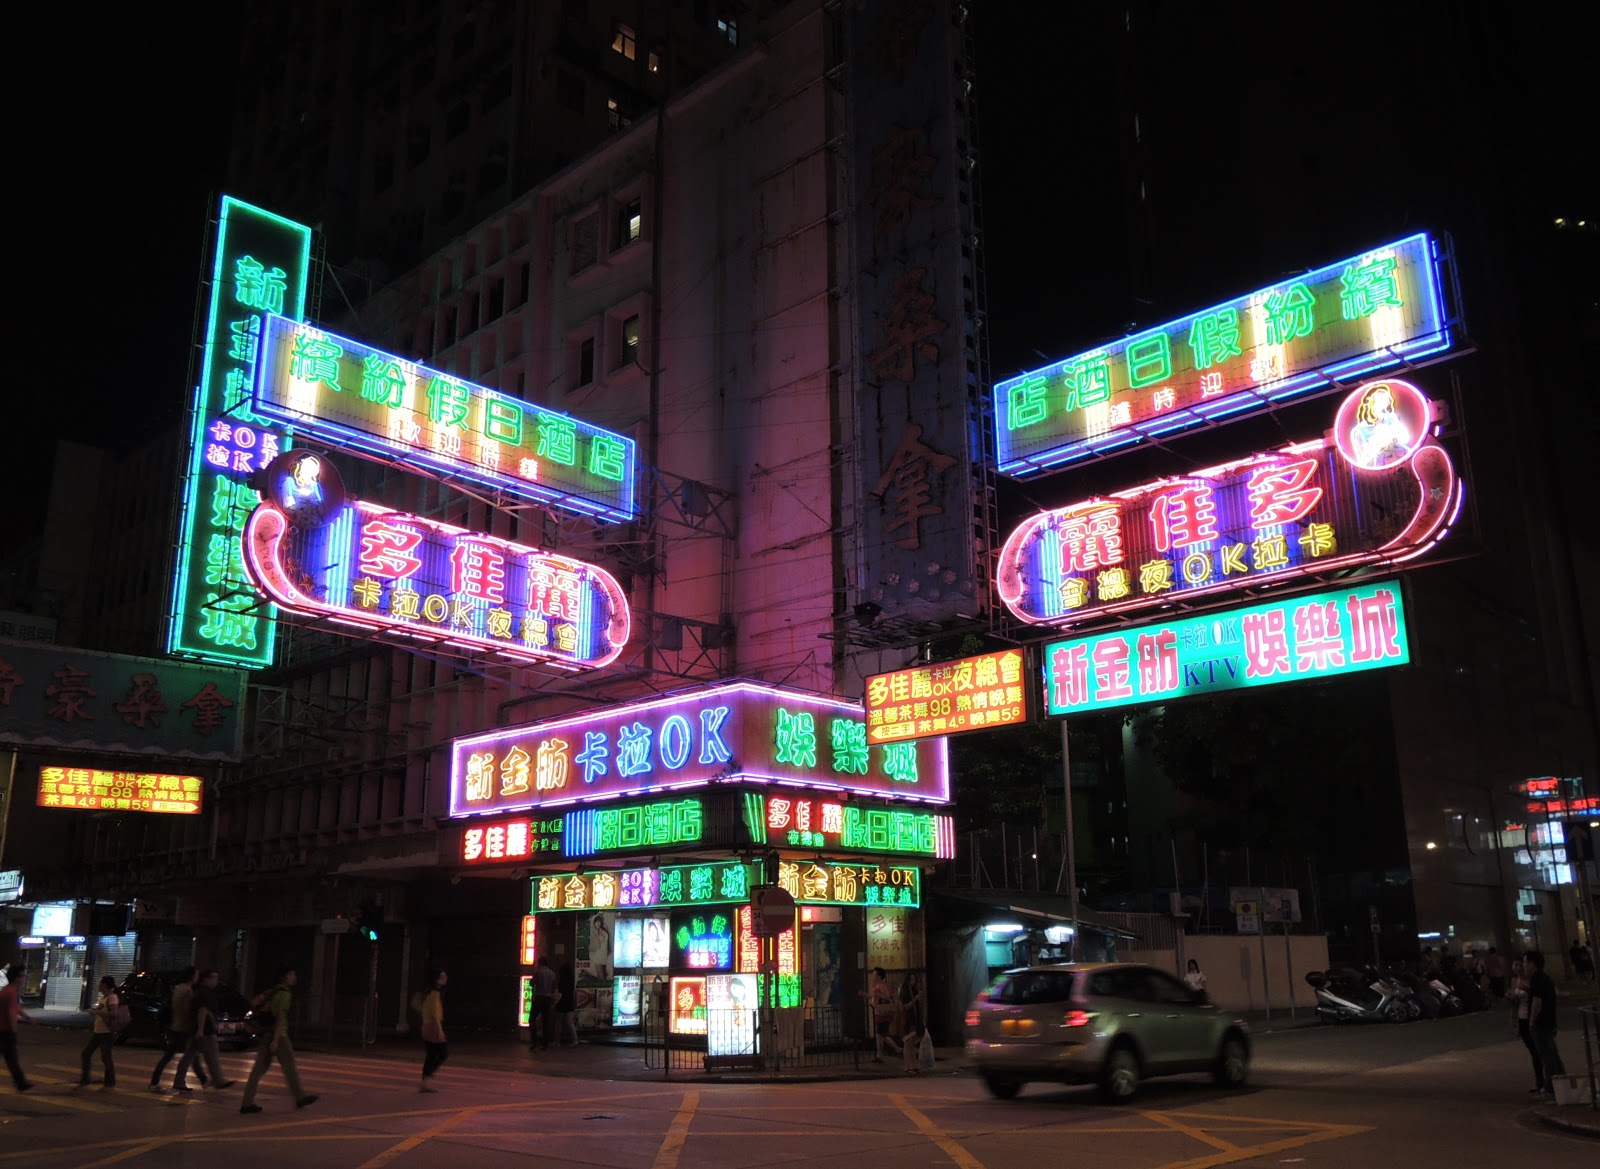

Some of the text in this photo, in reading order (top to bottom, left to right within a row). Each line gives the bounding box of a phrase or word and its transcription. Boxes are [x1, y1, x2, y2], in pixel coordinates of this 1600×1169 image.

[290, 330, 625, 482] 繽紛假日酒店
[358, 520, 581, 622] 多佳麗
[1182, 655, 1241, 689] KTV
[1242, 588, 1402, 679] 娛樂城
[868, 669, 933, 707] 多佳麗
[40, 767, 115, 787] 多佳麗
[595, 800, 703, 849] 假日酒店
[769, 799, 843, 834] 多佳麗
[842, 806, 937, 853] 假日酒店
[464, 822, 529, 861] 多佳麗
[538, 873, 616, 909] 新金舫
